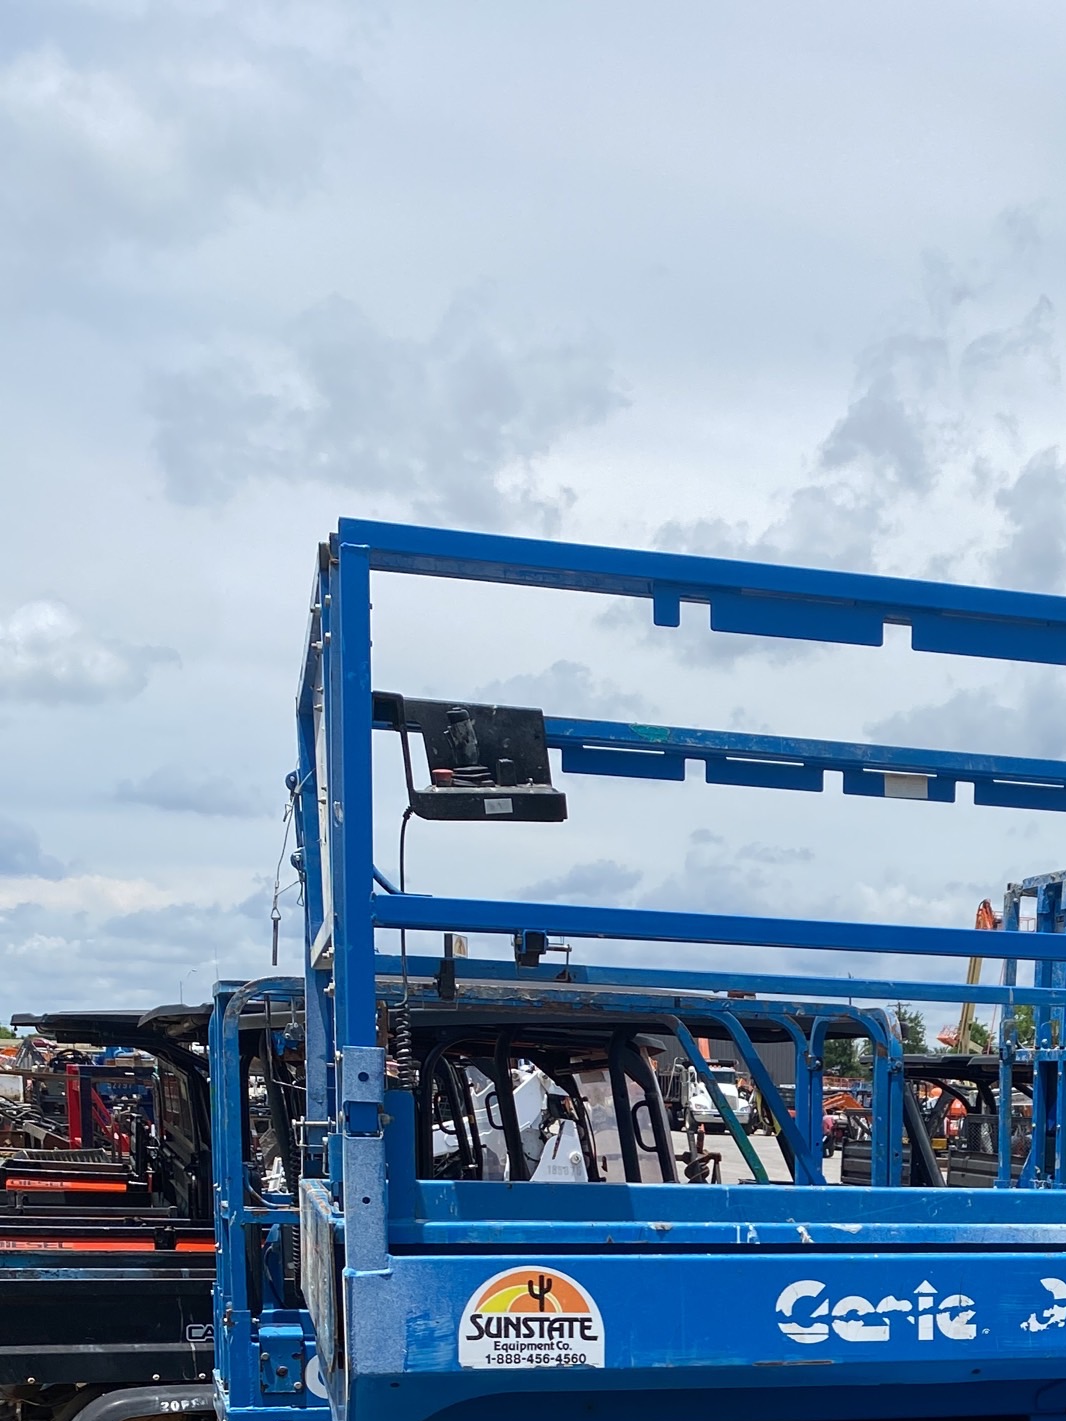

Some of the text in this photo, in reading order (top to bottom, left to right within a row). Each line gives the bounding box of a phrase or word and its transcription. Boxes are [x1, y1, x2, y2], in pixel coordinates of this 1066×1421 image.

[465, 1313, 599, 1342] SUNSTATE
[493, 1341, 573, 1353] Equipment Co.
[485, 1353, 587, 1364] 1-888-456-4560
